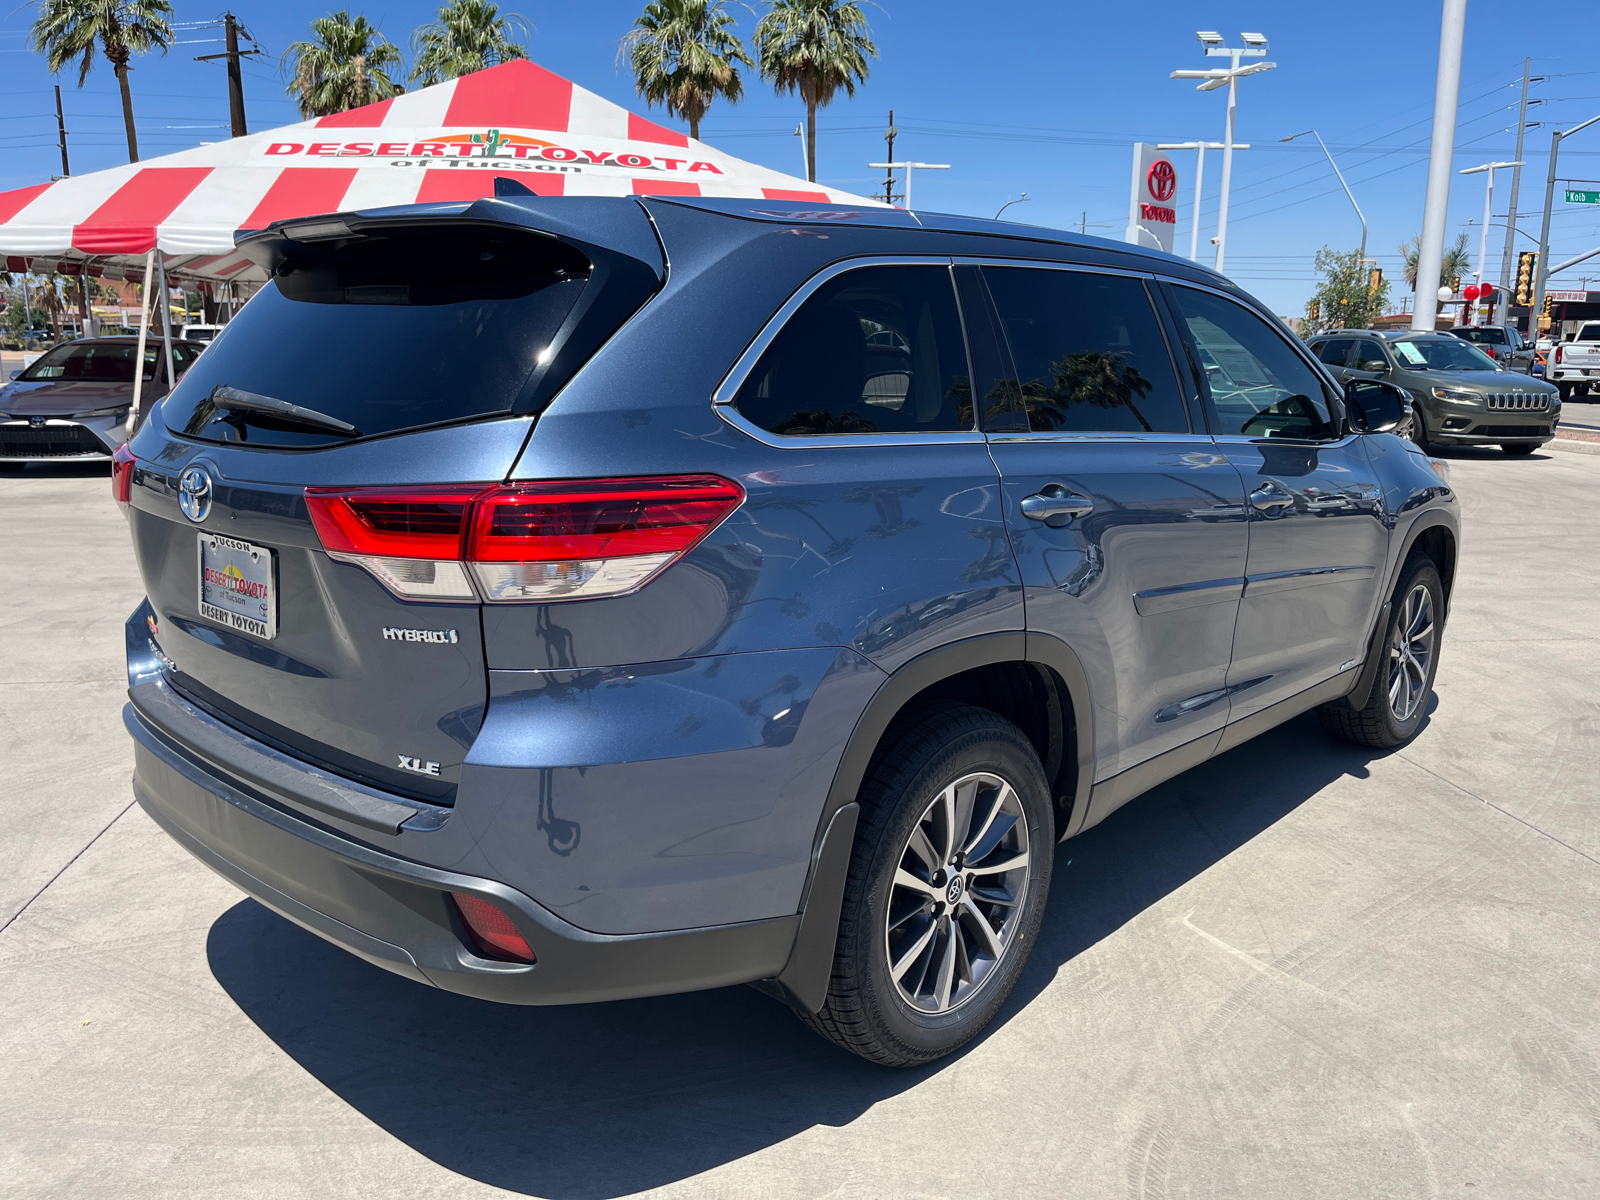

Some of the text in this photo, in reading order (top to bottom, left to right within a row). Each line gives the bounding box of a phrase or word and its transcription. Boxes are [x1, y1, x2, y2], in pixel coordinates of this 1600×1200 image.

[264, 142, 725, 175] DESERT TOYOTA
[390, 159, 582, 173] of Tucson
[1570, 191, 1586, 202] Kolb
[1140, 203, 1176, 224] TOYOTA
[215, 536, 250, 552] TUCSON
[205, 567, 268, 599] DESERT TOYOTA
[226, 591, 246, 605] Tucson
[201, 602, 267, 637] DESERT TOYOTA
[382, 627, 447, 643] HYBRID
[398, 754, 441, 776] XLE
